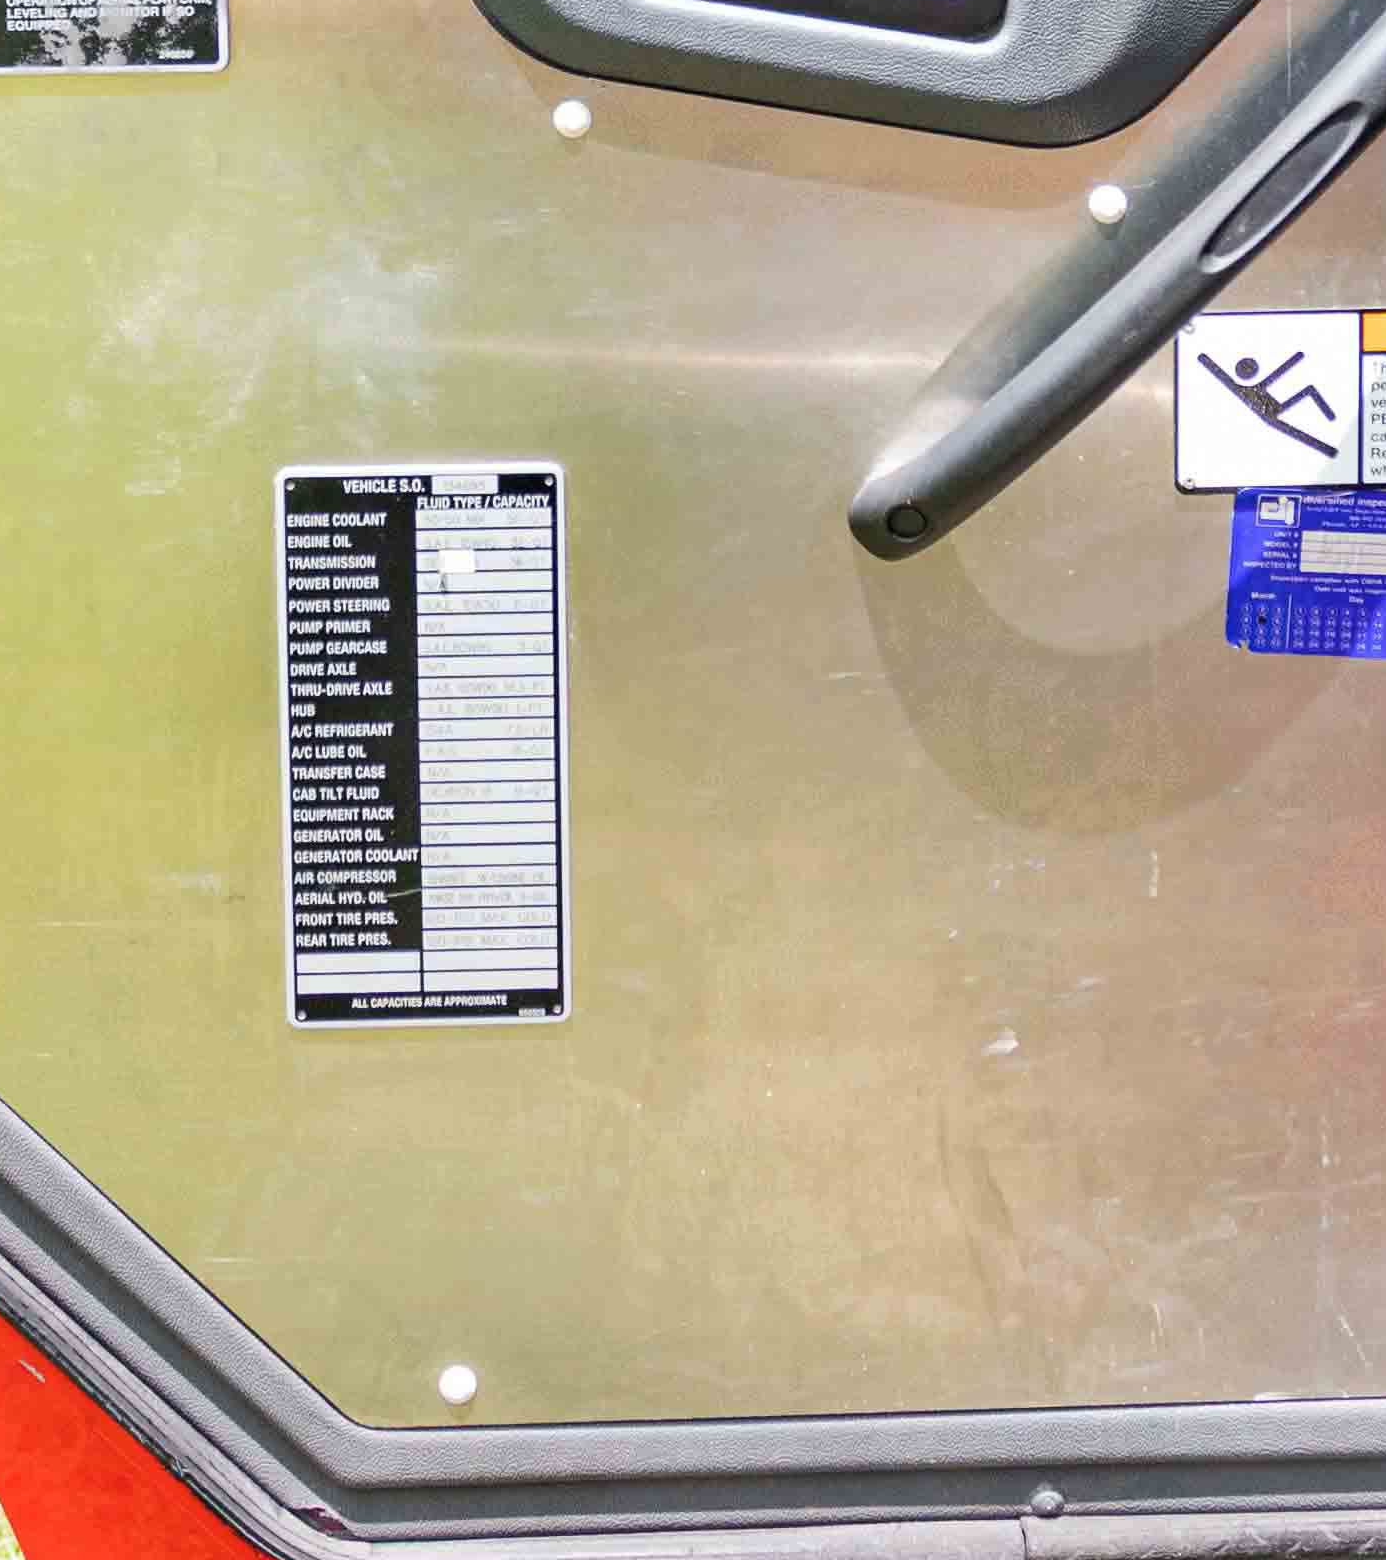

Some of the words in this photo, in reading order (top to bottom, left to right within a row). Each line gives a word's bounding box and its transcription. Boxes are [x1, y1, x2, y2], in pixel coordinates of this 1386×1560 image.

[69, 6, 96, 19] AND
[343, 479, 397, 494] VEHICLE
[400, 479, 425, 493] S.O.
[417, 496, 450, 510] FLUID
[453, 496, 481, 509] TYPE
[492, 495, 549, 509] CAPACITY
[287, 514, 330, 527] ENGINE
[332, 513, 387, 527] COOLANT
[287, 536, 330, 548] ENGINE
[333, 535, 352, 548] OIL
[288, 556, 376, 570] TRANSMISSION
[289, 577, 330, 590] POWER
[333, 576, 379, 590] DIVIDER
[289, 600, 330, 613] POWER
[333, 598, 390, 612] STEERING
[289, 621, 322, 634] PUMP
[325, 620, 371, 633] PRIMER
[289, 642, 322, 655] PUMP
[325, 641, 388, 655] GEARCASE
[290, 663, 325, 677] DRIVE
[327, 662, 356, 675] AXLE
[291, 683, 360, 696] THRU-DRIVE
[363, 682, 393, 695] AXLE
[291, 704, 315, 717] HUB
[292, 725, 313, 738] A/C
[315, 723, 394, 737] REFRIGERANT
[292, 746, 313, 759] A/C
[315, 746, 345, 758] LUBE
[348, 745, 366, 758] OIL
[293, 766, 352, 780] TRANSFER
[355, 765, 386, 779] CASE
[293, 788, 317, 801] CAB
[319, 787, 344, 800] TILT
[347, 786, 379, 800] FLUID
[293, 808, 360, 822] EQUIPMENT
[362, 807, 394, 820] RACK
[294, 829, 363, 843] GENERATOR
[365, 829, 384, 841] OIL
[294, 850, 363, 864] GENERATOR
[365, 849, 419, 862] COOLANT
[294, 871, 315, 884] AIR
[317, 870, 396, 884] COMPRESSOR
[295, 892, 336, 906] AERIAL
[338, 892, 366, 905] HYD.
[369, 891, 387, 904] OIL
[295, 913, 334, 927] FRONT
[336, 913, 361, 925] TIRE
[364, 912, 398, 925] PRES.
[296, 934, 328, 947] REAR
[330, 934, 355, 946] TIRE
[358, 933, 391, 945] PRES.
[352, 997, 368, 1008] ALL
[370, 996, 422, 1007] CAPACITIES
[424, 995, 443, 1007] ARE
[444, 994, 507, 1006] APPROXIMATE
